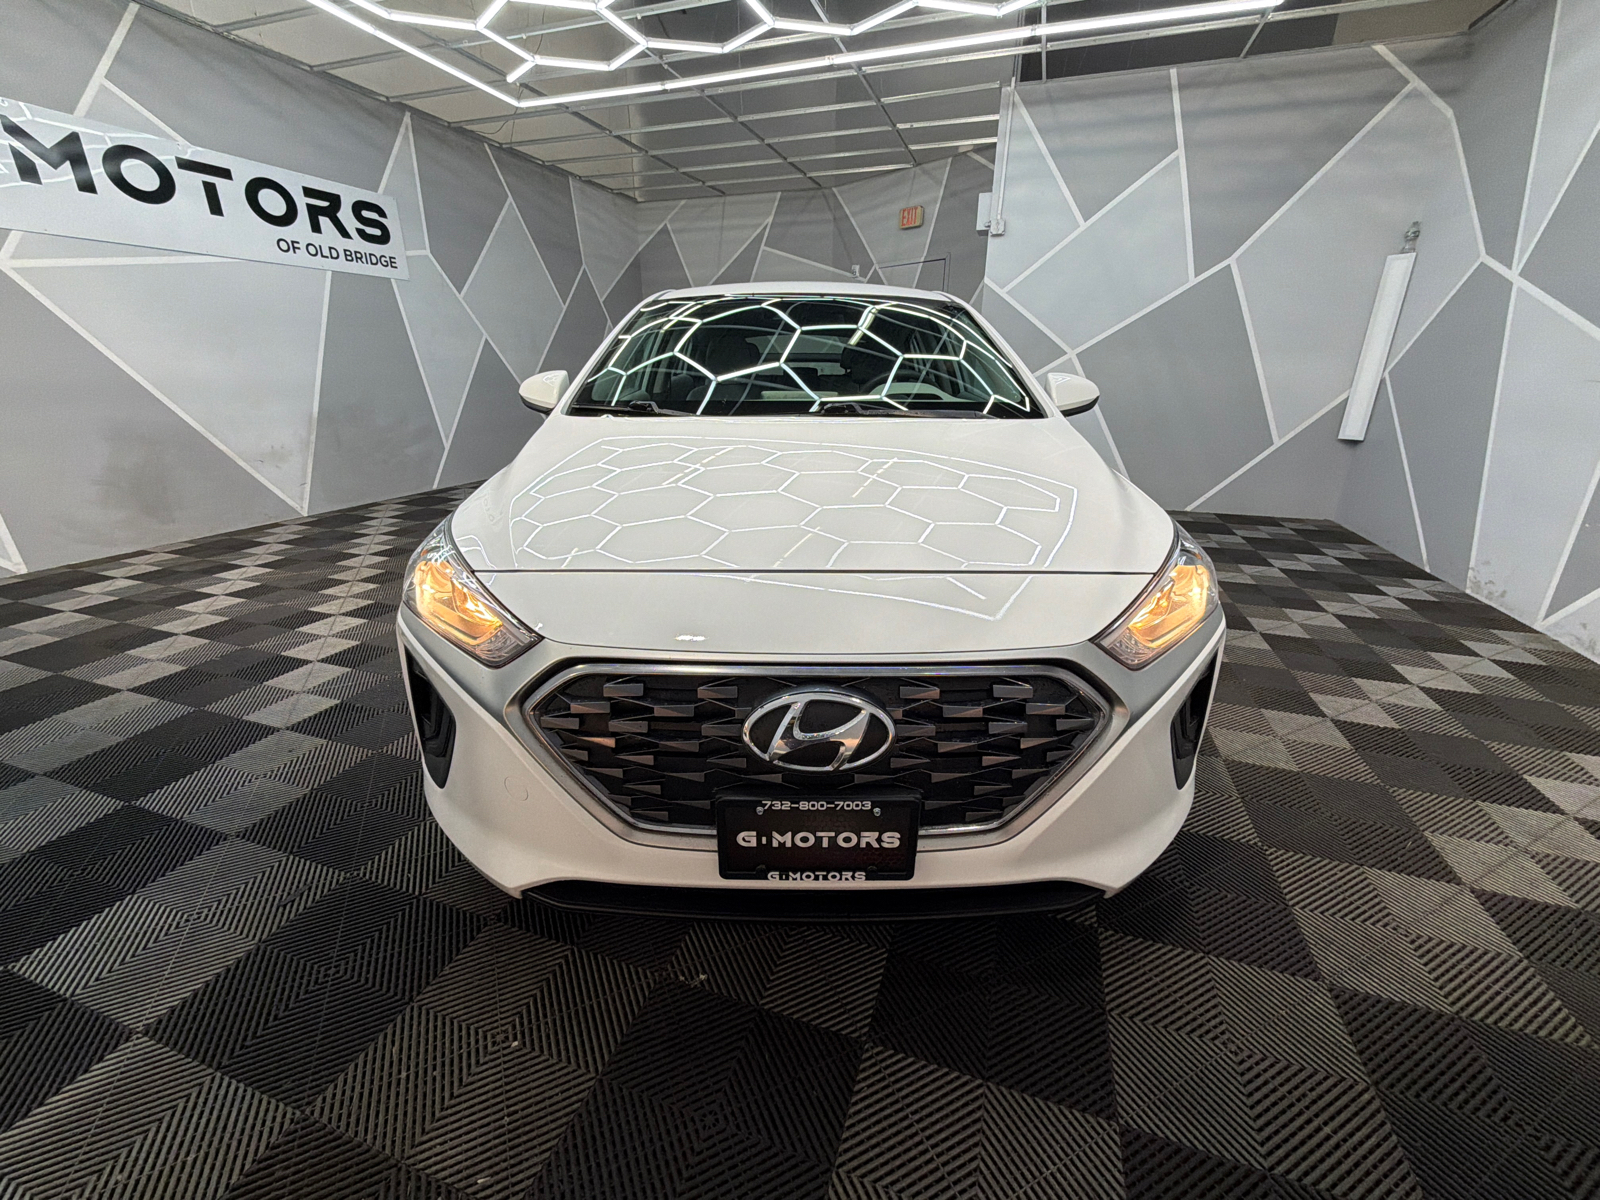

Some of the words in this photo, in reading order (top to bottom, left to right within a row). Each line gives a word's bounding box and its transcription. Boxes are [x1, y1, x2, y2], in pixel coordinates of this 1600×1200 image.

[0, 114, 391, 246] MOTORS
[901, 206, 918, 227] EXIT
[276, 238, 301, 254] OF
[305, 242, 340, 260] OLD
[343, 248, 398, 269] BRIDGE
[762, 801, 872, 811] 732-800-7003
